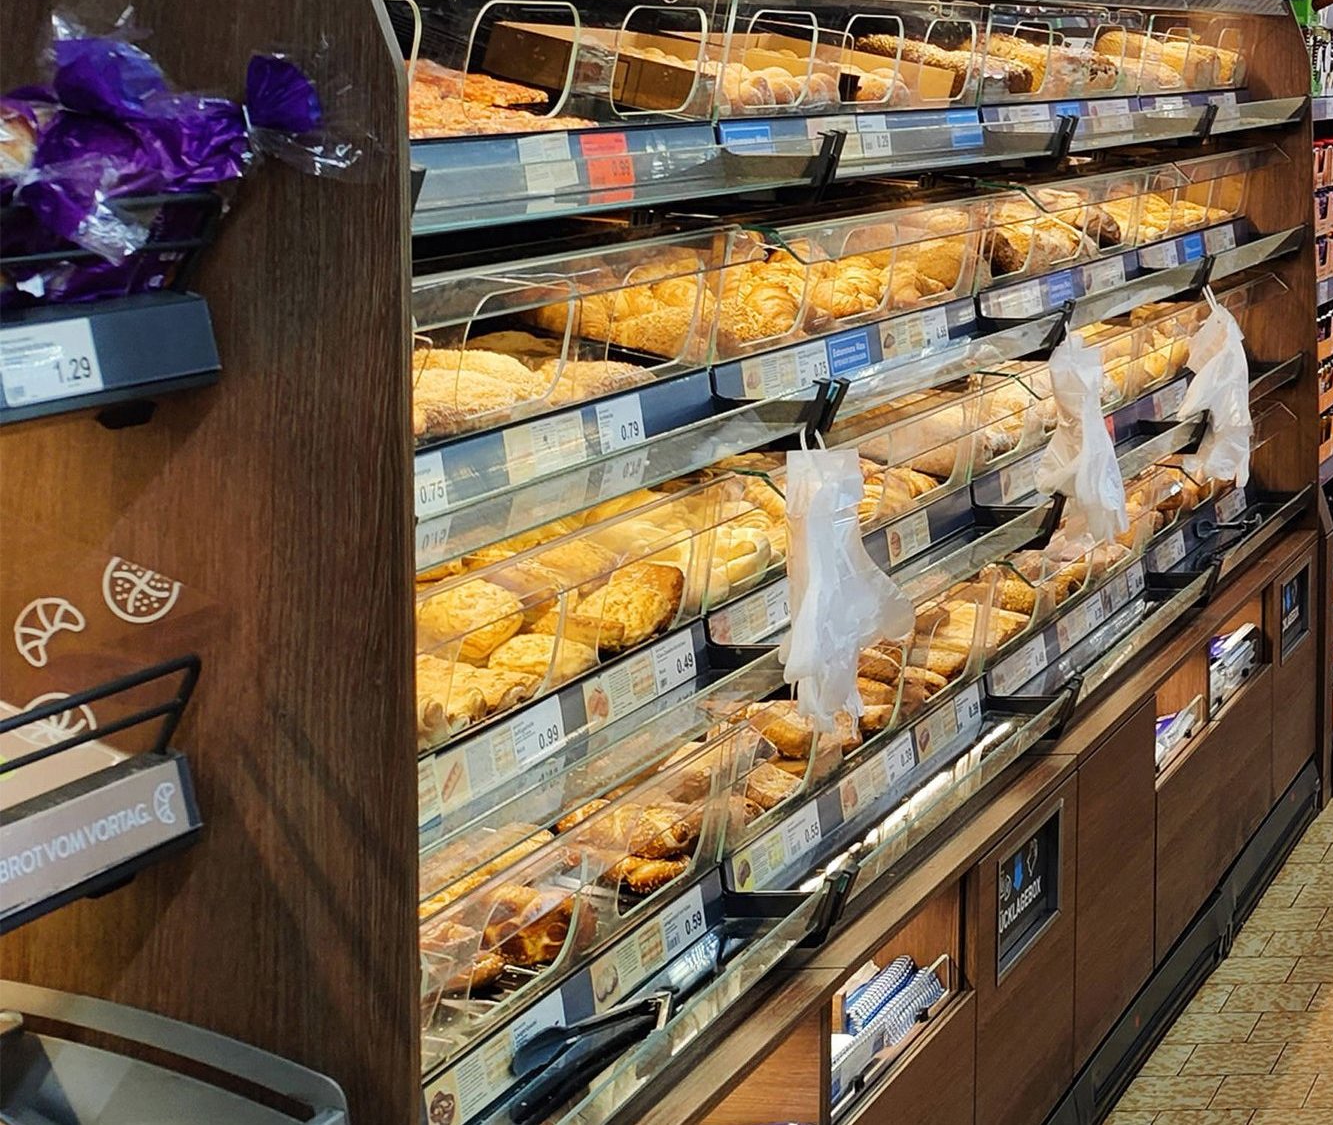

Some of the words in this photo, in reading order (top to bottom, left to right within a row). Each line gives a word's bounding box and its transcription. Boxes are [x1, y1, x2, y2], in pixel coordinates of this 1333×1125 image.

[53, 356, 93, 385] 1.29
[620, 419, 640, 442] 0.79
[419, 480, 445, 506] 0.75
[676, 651, 695, 675] 0.49
[538, 725, 560, 751] 0.99
[44, 829, 87, 862] VOM
[83, 803, 153, 846] VORTAG.
[804, 820, 820, 844] 0.55
[999, 875, 1042, 934] ÜCKLAGEBOX
[684, 910, 703, 936] 0.59
